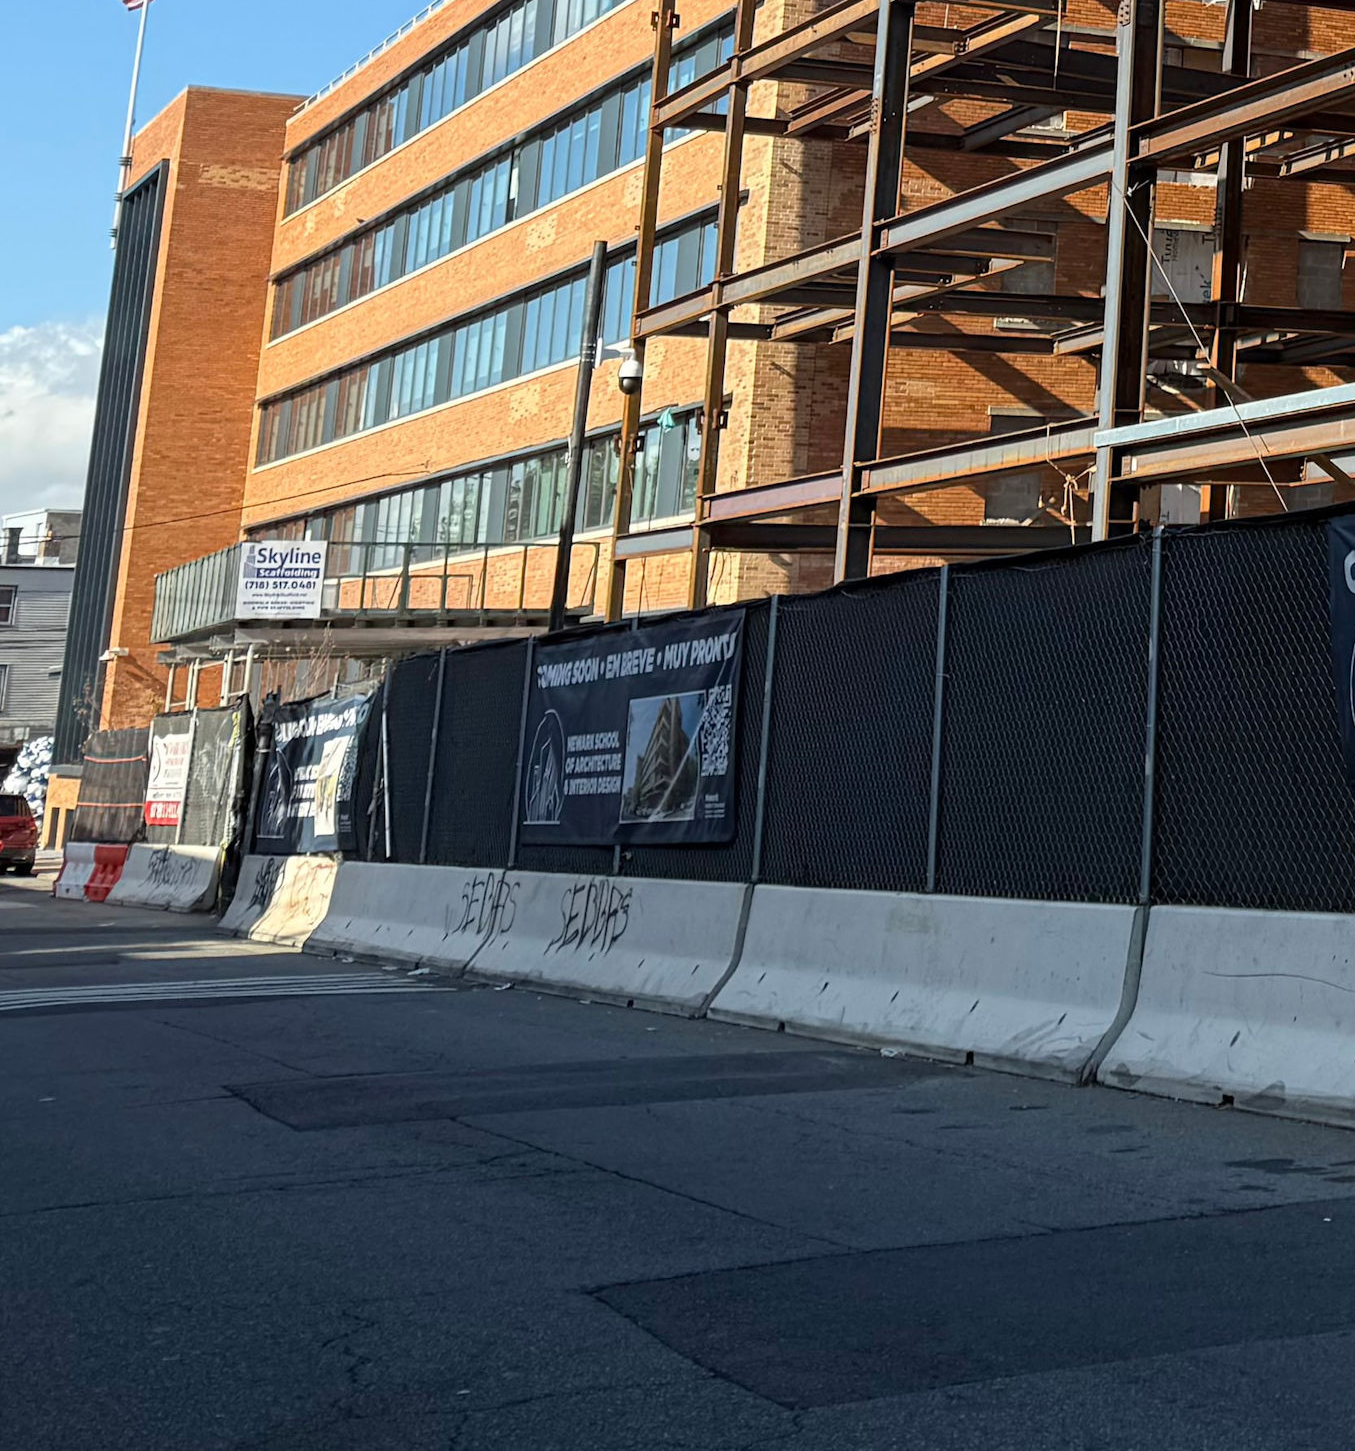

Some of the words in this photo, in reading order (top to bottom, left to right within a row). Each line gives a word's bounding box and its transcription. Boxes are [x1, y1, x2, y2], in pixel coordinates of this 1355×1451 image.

[257, 547, 321, 569] Skyline
[259, 568, 318, 578] Scaffolding
[572, 657, 599, 684] SOON
[605, 654, 621, 679] EM
[621, 648, 655, 676] BREVE
[663, 642, 691, 670] MUY
